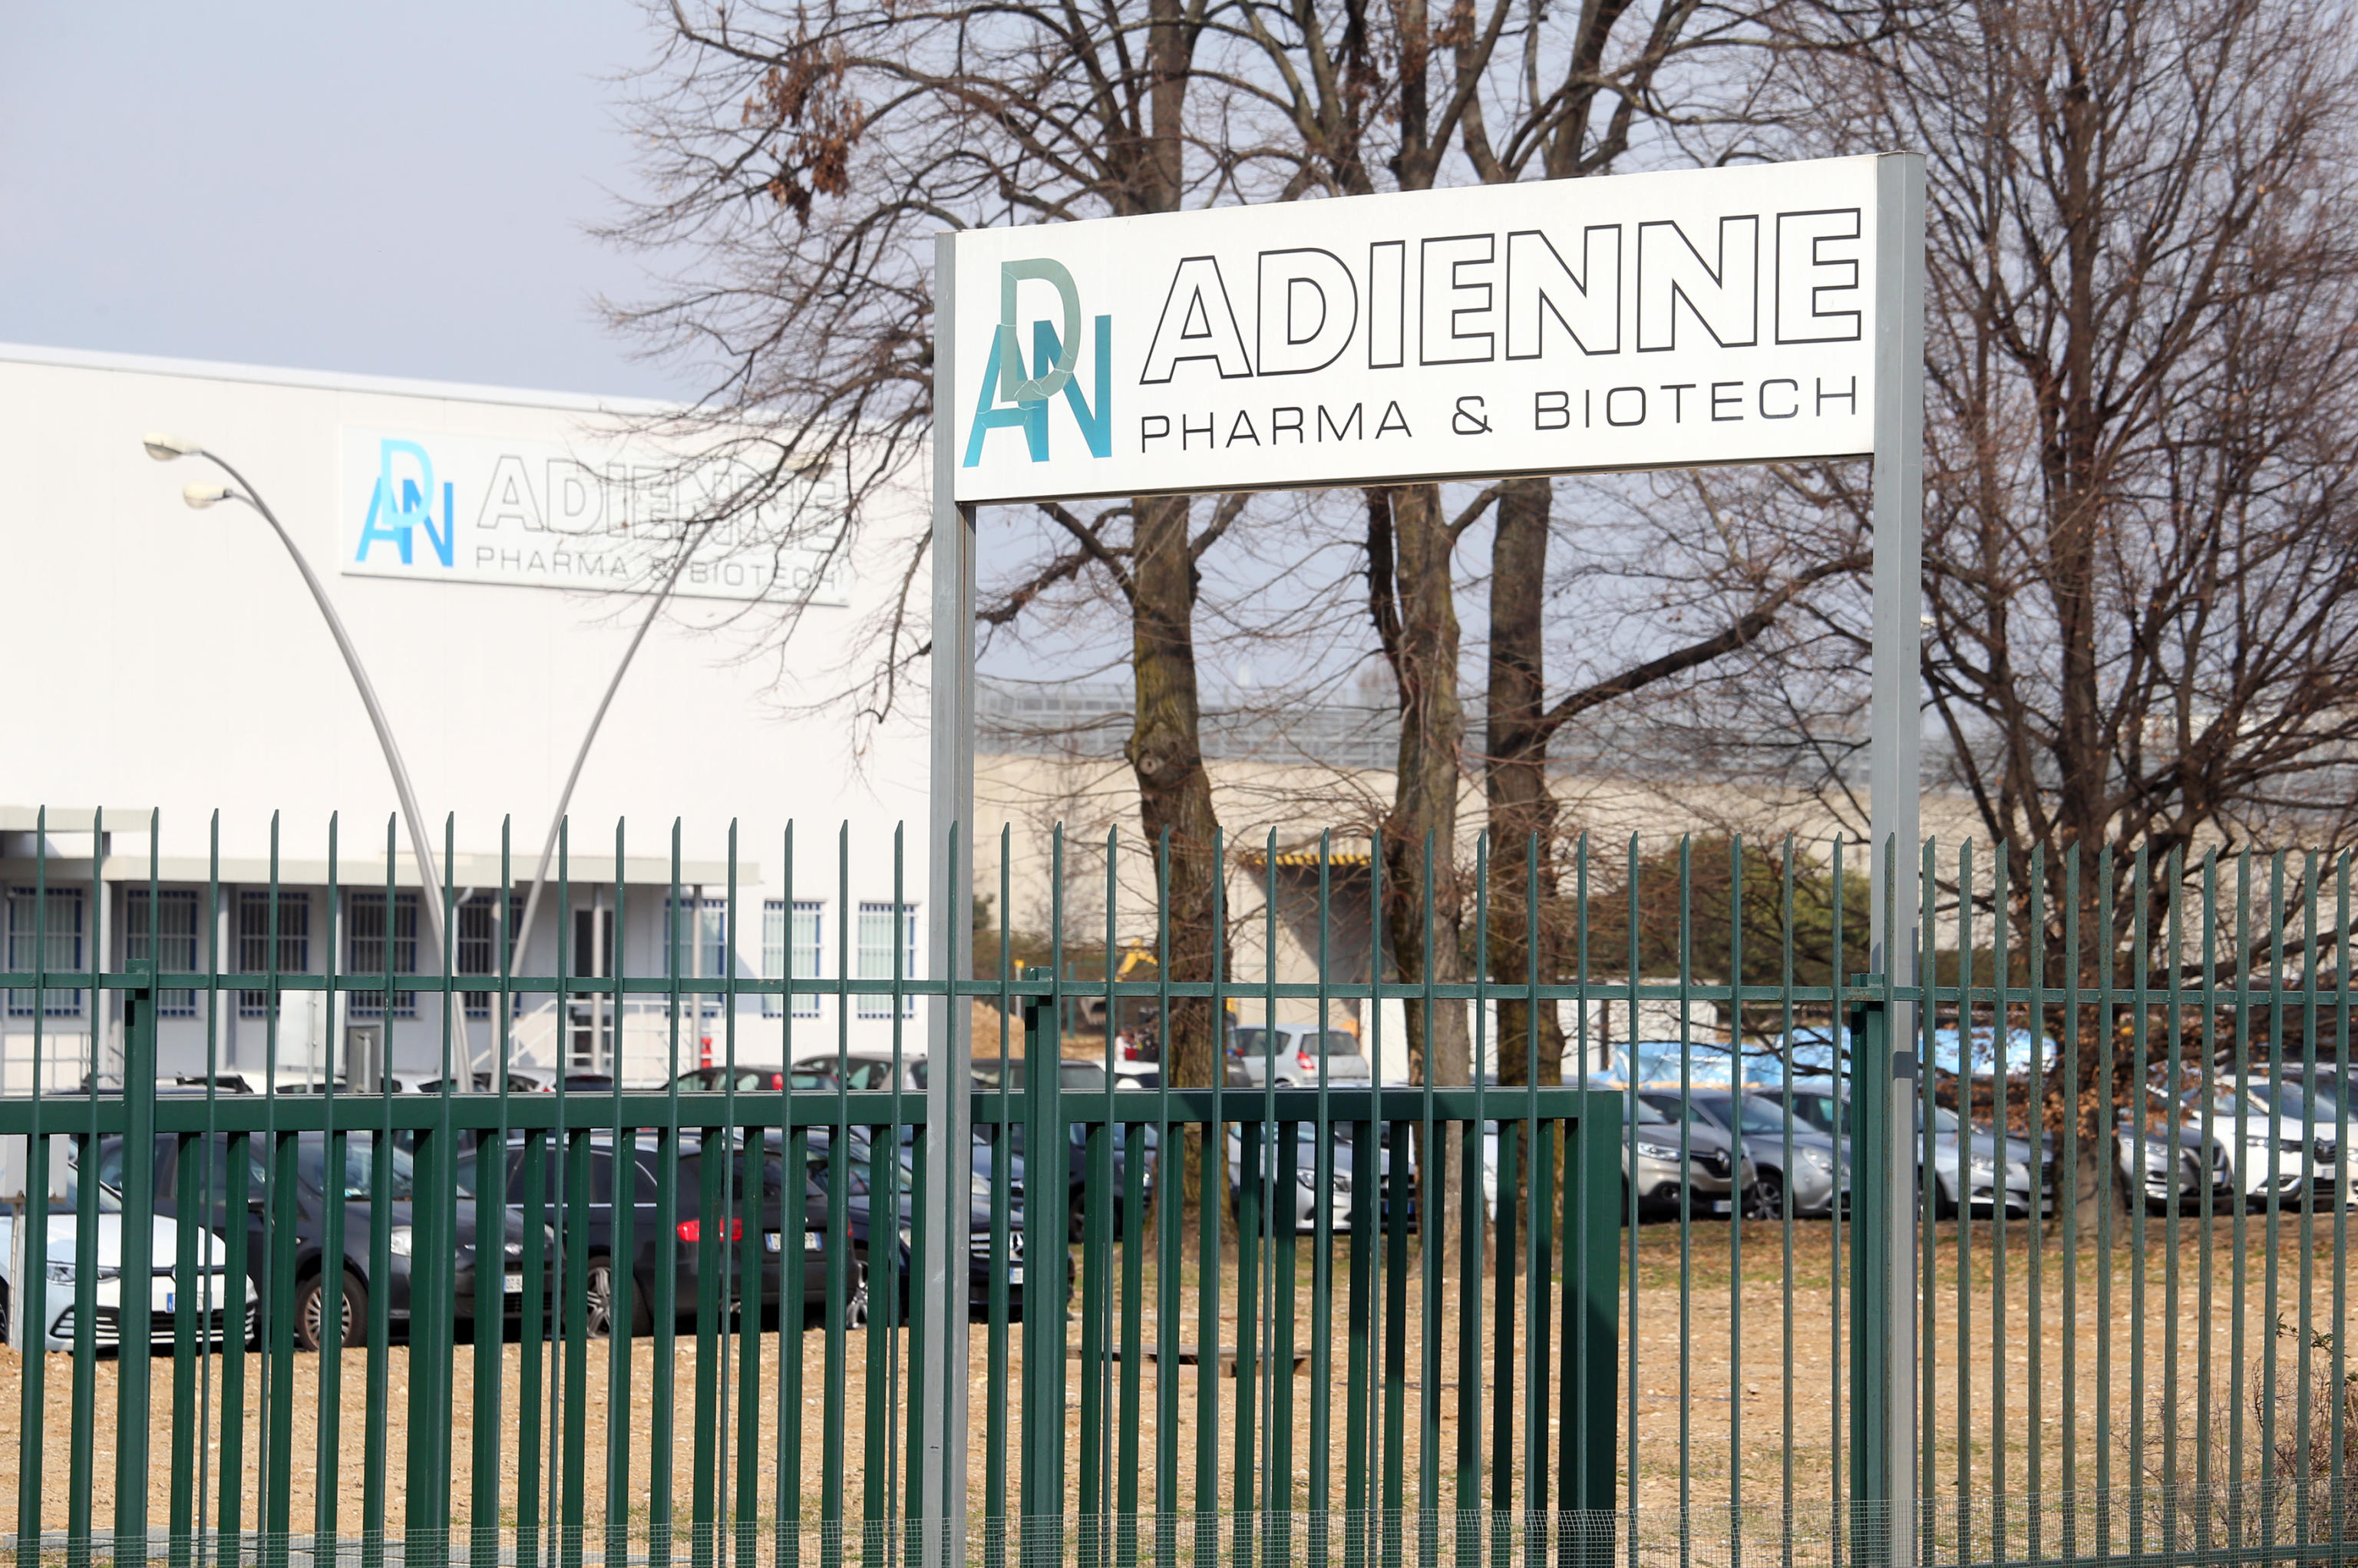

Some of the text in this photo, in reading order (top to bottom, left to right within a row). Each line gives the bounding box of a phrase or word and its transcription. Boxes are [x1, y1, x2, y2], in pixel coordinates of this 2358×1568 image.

[1140, 207, 1861, 385] ADIENNE
[1141, 375, 1856, 454] PHARMA & BIOTECH
[477, 454, 835, 553] ADIENNE
[477, 546, 629, 577] PHARMA
